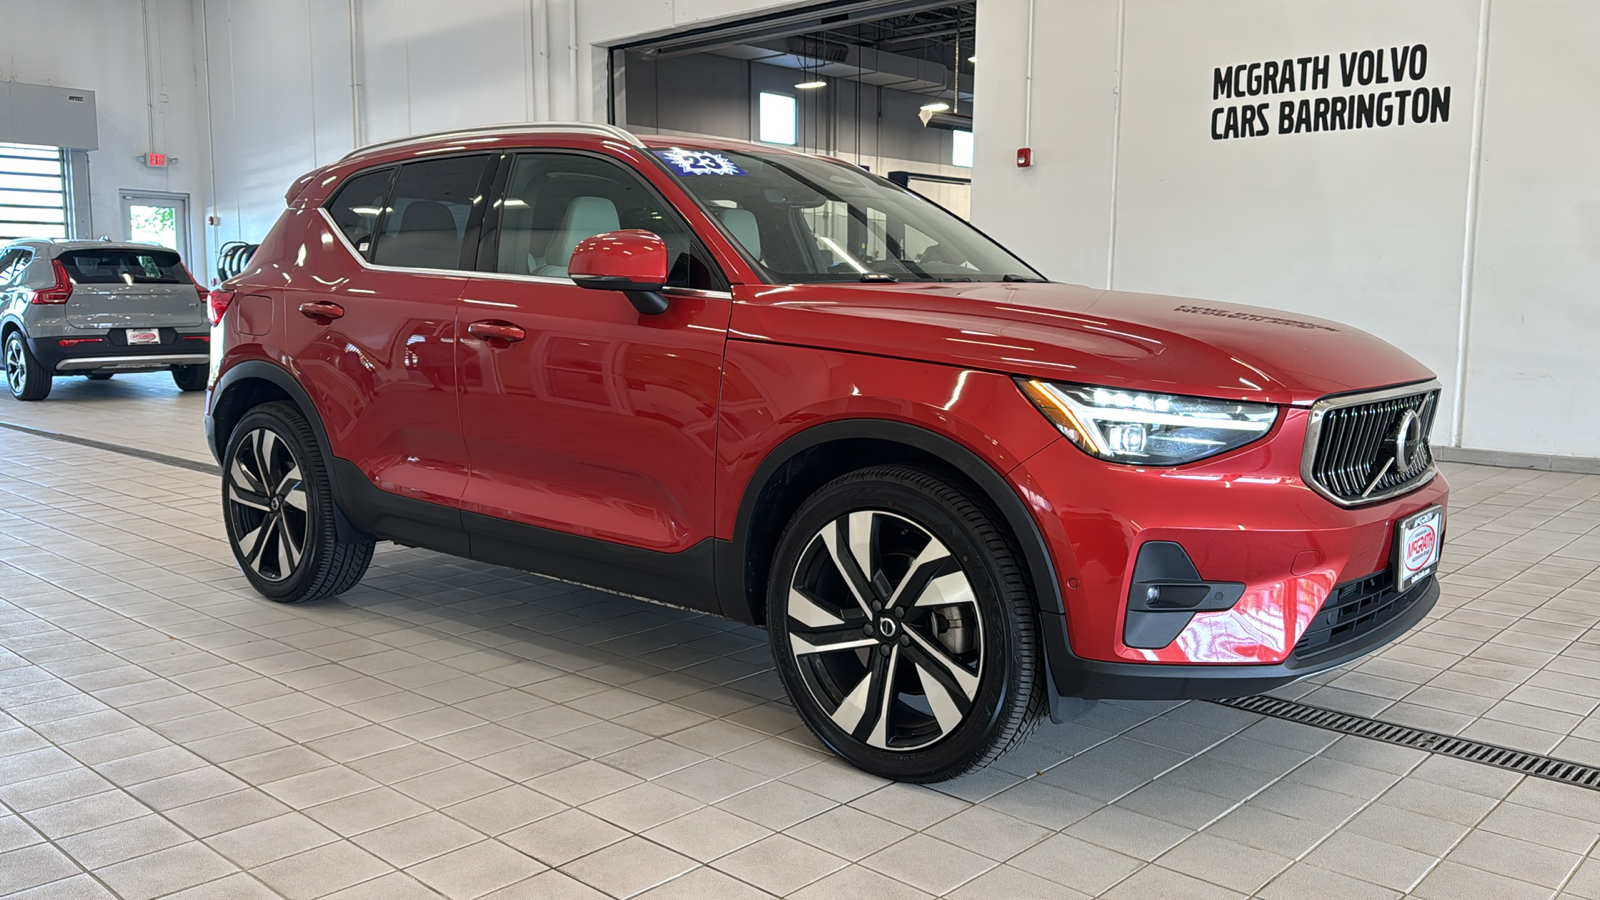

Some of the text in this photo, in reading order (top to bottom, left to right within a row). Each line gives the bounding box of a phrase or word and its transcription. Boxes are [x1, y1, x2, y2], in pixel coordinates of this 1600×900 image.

[1213, 44, 1427, 100] MCGRATH VOLVO
[1211, 86, 1451, 140] CARS BARRINGTON
[149, 153, 165, 165] EXIT
[682, 155, 723, 169] 23
